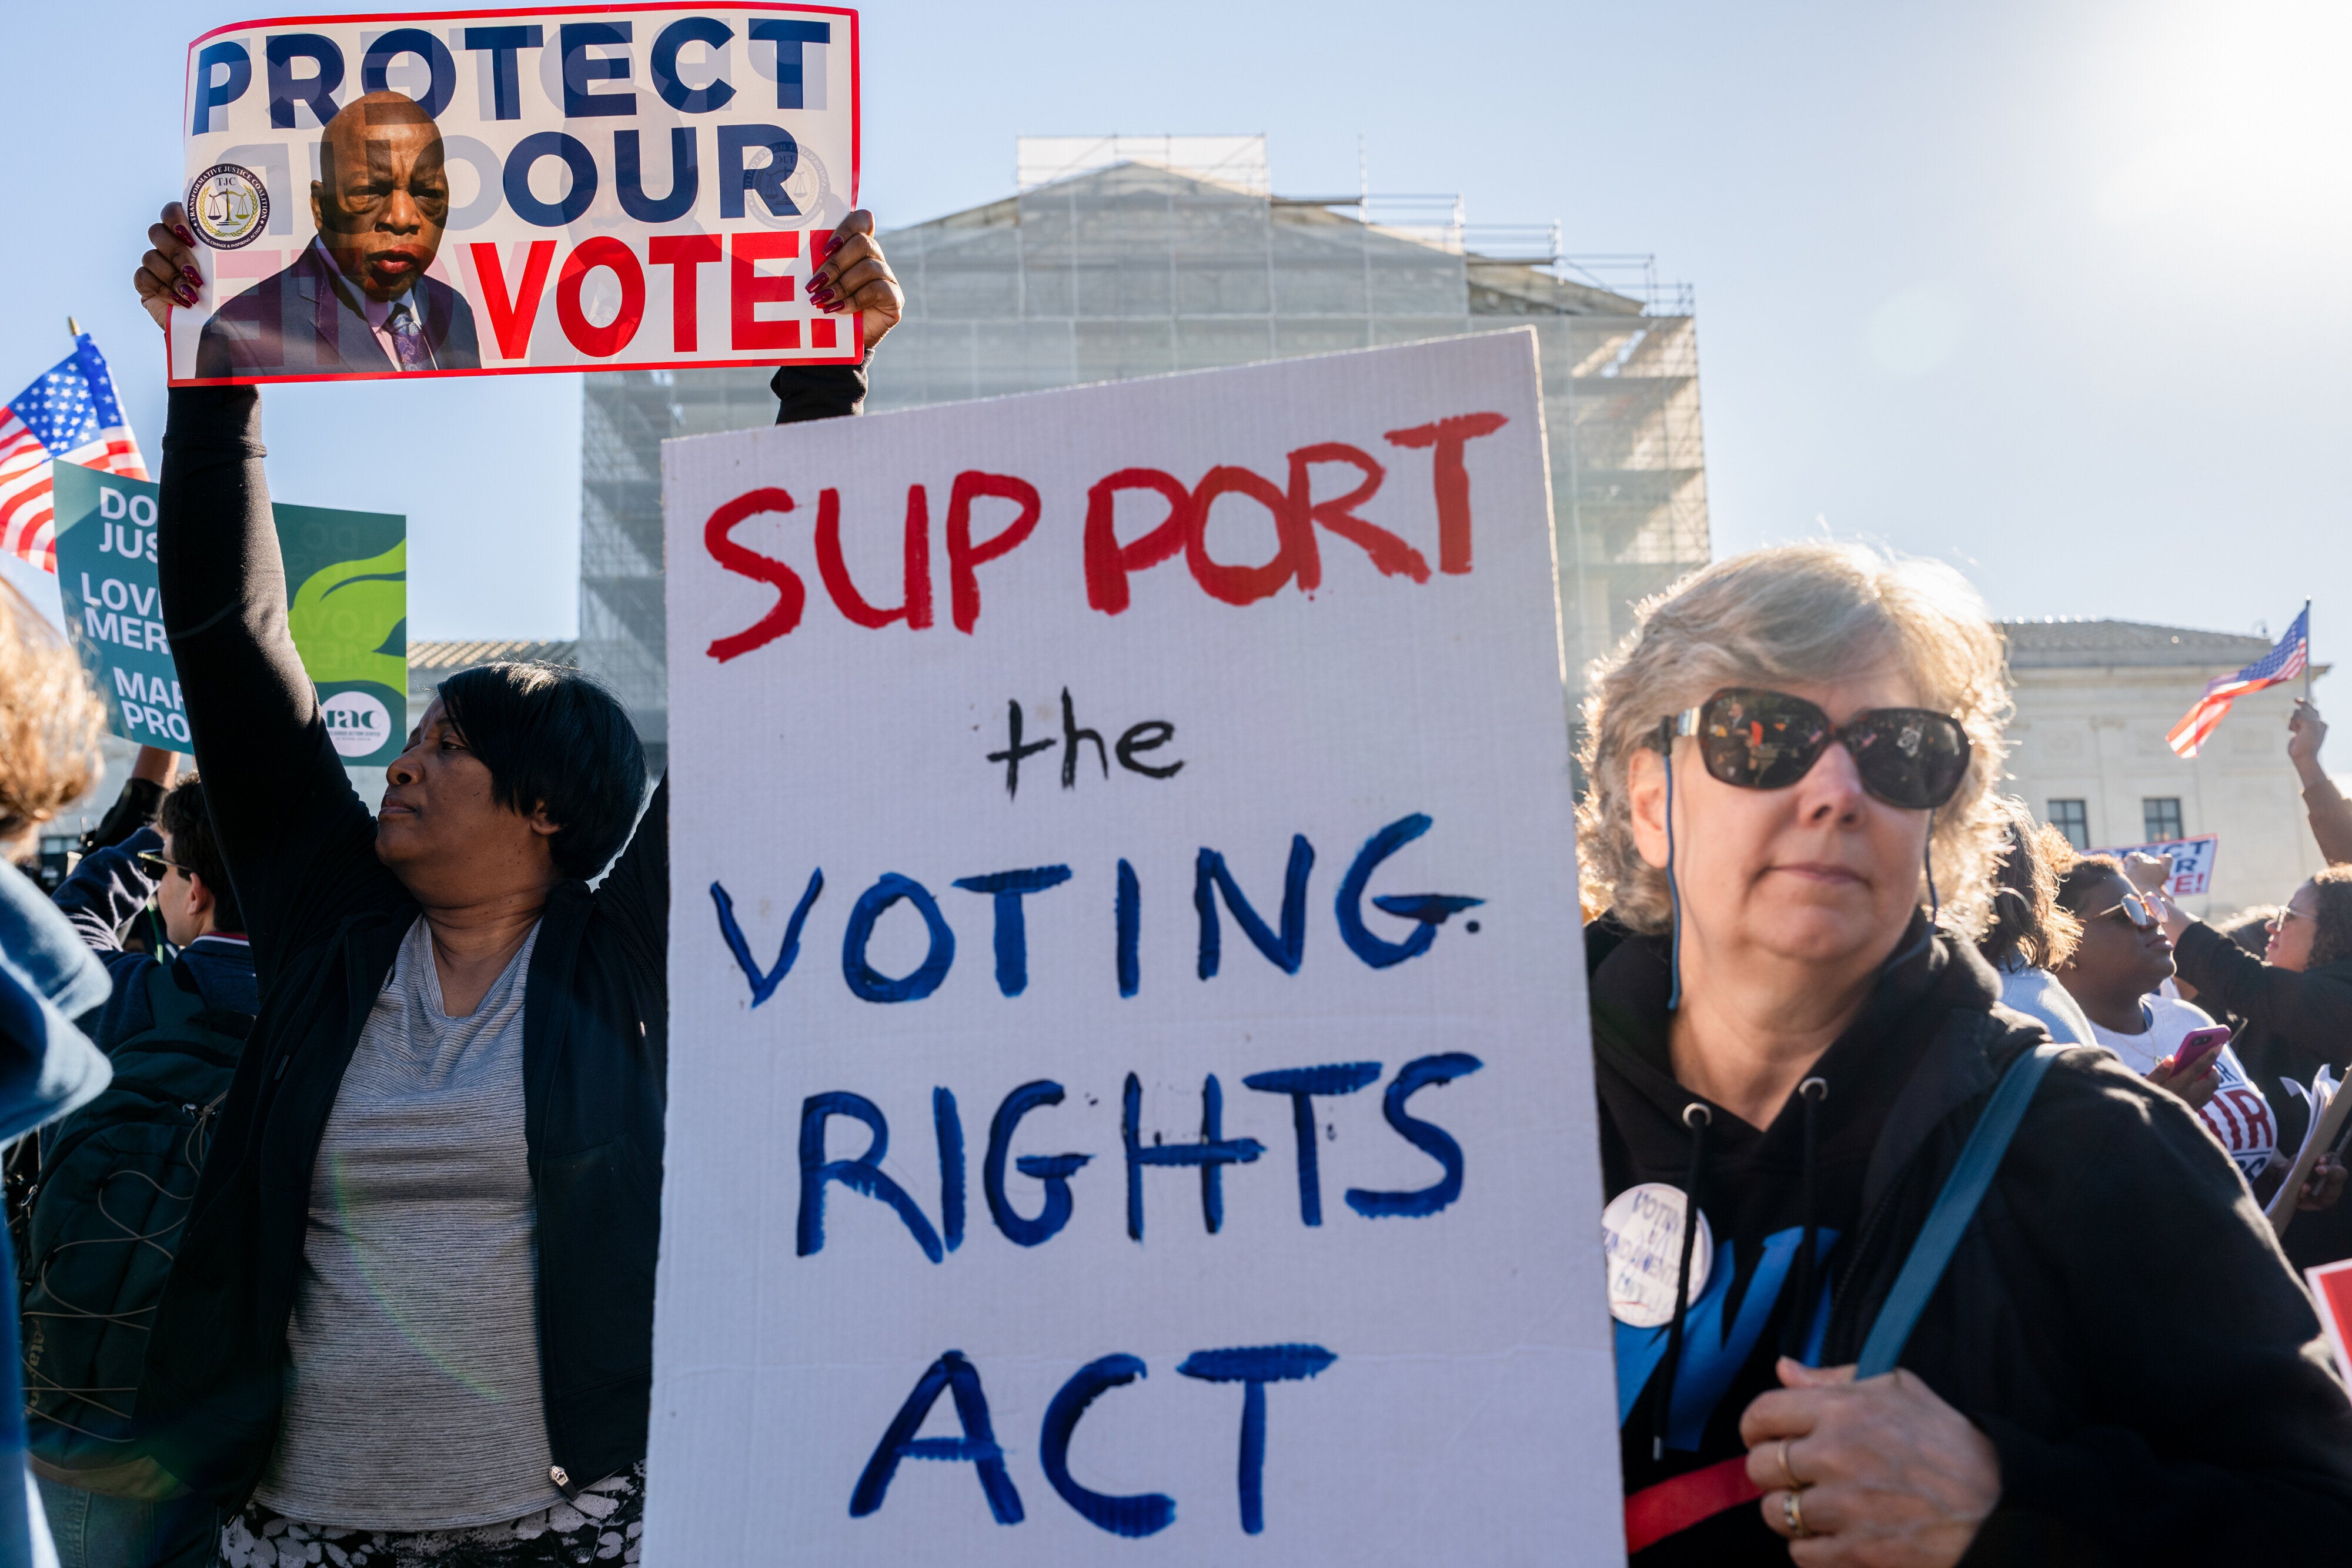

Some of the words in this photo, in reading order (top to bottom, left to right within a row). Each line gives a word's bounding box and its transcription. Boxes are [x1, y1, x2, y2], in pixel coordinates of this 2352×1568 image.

[193, 16, 831, 136] PROTECT
[189, 166, 223, 222] TRANSFORMATIVE
[223, 166, 252, 180] JUSTICE
[252, 179, 268, 219] COALITION
[216, 178, 236, 186] TJC
[503, 124, 802, 227] OUR
[196, 228, 211, 243] IGNITING
[230, 238, 251, 248] INSPIRING
[250, 225, 262, 239] ACTION
[99, 486, 157, 527] DO
[704, 413, 1508, 663] SUPPORT
[987, 687, 1184, 798] the
[796, 1052, 1484, 1264] RIGHTS
[848, 1343, 1338, 1539] ACT
